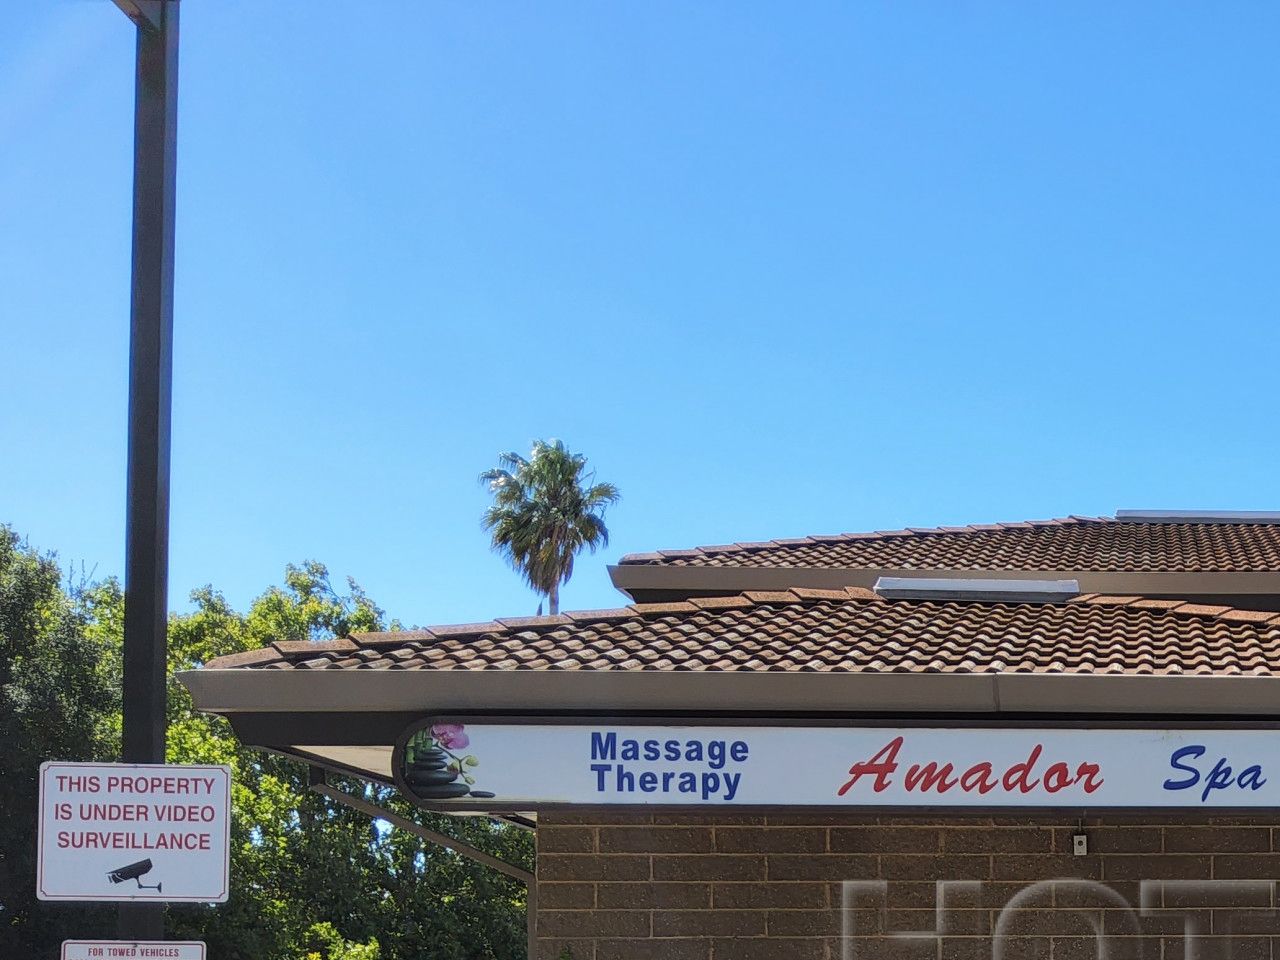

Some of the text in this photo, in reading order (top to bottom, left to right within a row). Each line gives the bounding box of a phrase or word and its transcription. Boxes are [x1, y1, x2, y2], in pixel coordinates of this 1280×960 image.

[590, 732, 749, 769] Massage
[837, 736, 1267, 802] Amador Spa
[55, 776, 216, 795] THIS PROPERTY
[590, 764, 741, 800] Therapy
[54, 803, 216, 823] IS UNDER VIDEO
[57, 831, 211, 850] SURVEILLANCE
[88, 947, 180, 957] FOR TOWED VEHICLES
